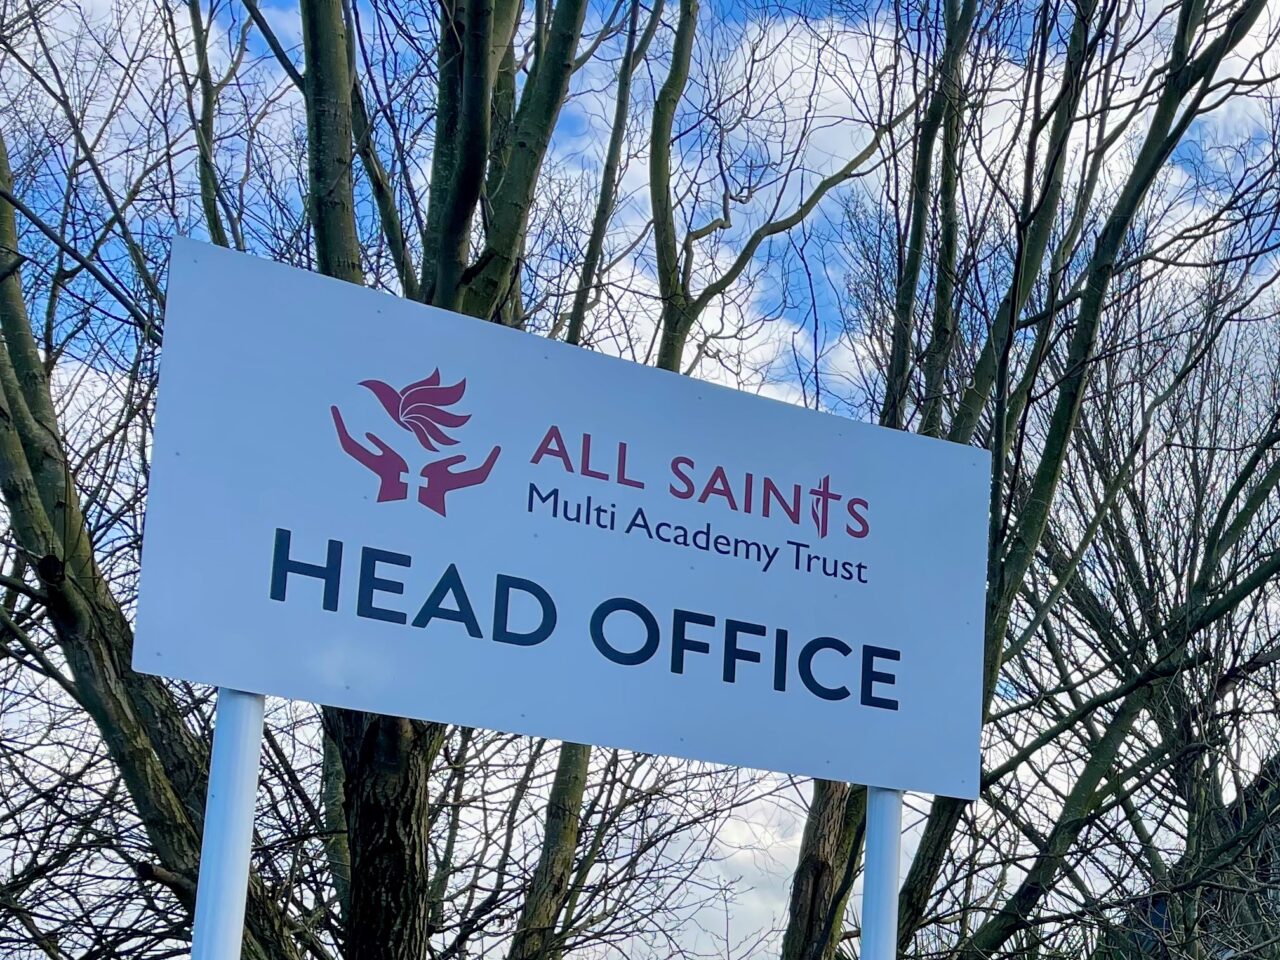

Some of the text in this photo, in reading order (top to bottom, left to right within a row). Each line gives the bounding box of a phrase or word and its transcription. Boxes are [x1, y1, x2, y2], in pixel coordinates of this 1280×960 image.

[527, 481, 869, 584] Multi Academy Trust
[529, 424, 870, 539] ALL SAINTS
[269, 527, 902, 713] HEAD OFFICE
